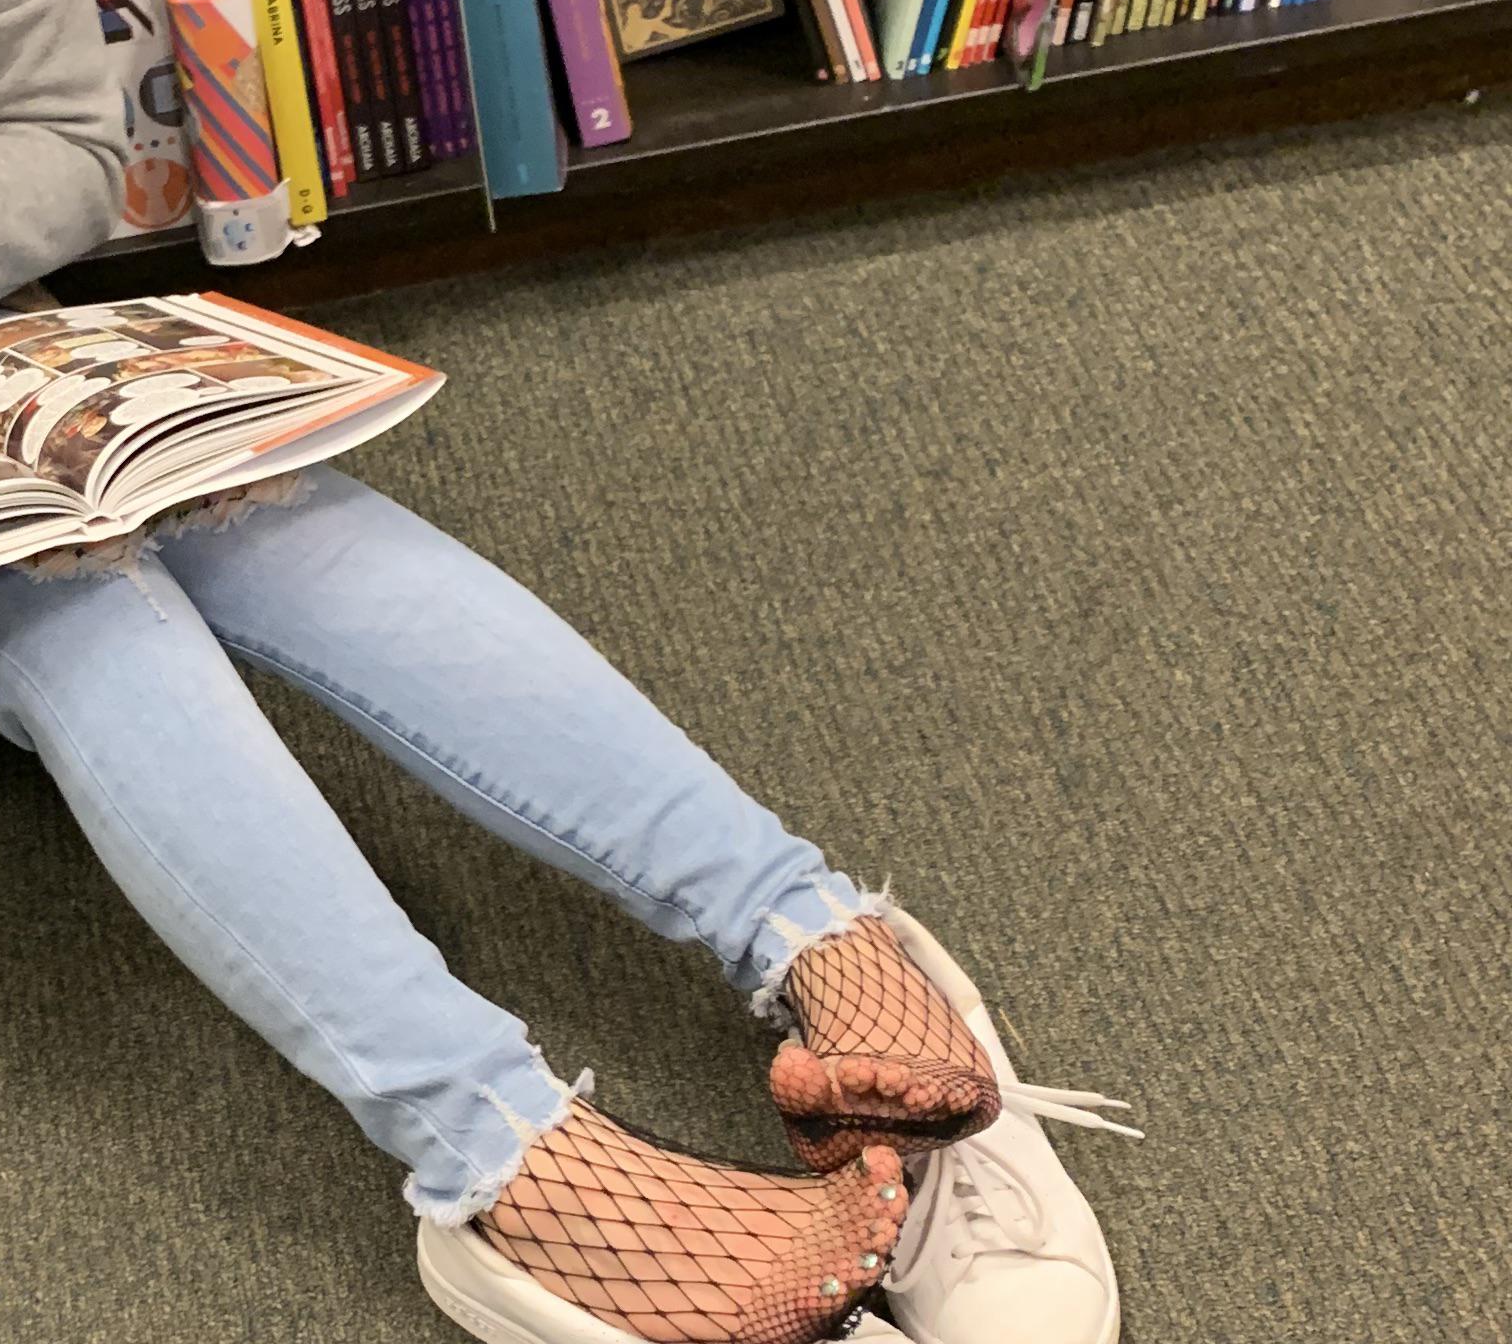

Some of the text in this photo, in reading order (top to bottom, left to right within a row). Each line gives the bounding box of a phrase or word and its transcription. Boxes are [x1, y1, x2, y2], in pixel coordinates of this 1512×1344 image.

[404, 115, 422, 162] ARCHAIA
[590, 107, 613, 131] 2
[355, 124, 374, 172] ARCHAIA
[378, 120, 397, 167] ARCHAIA
